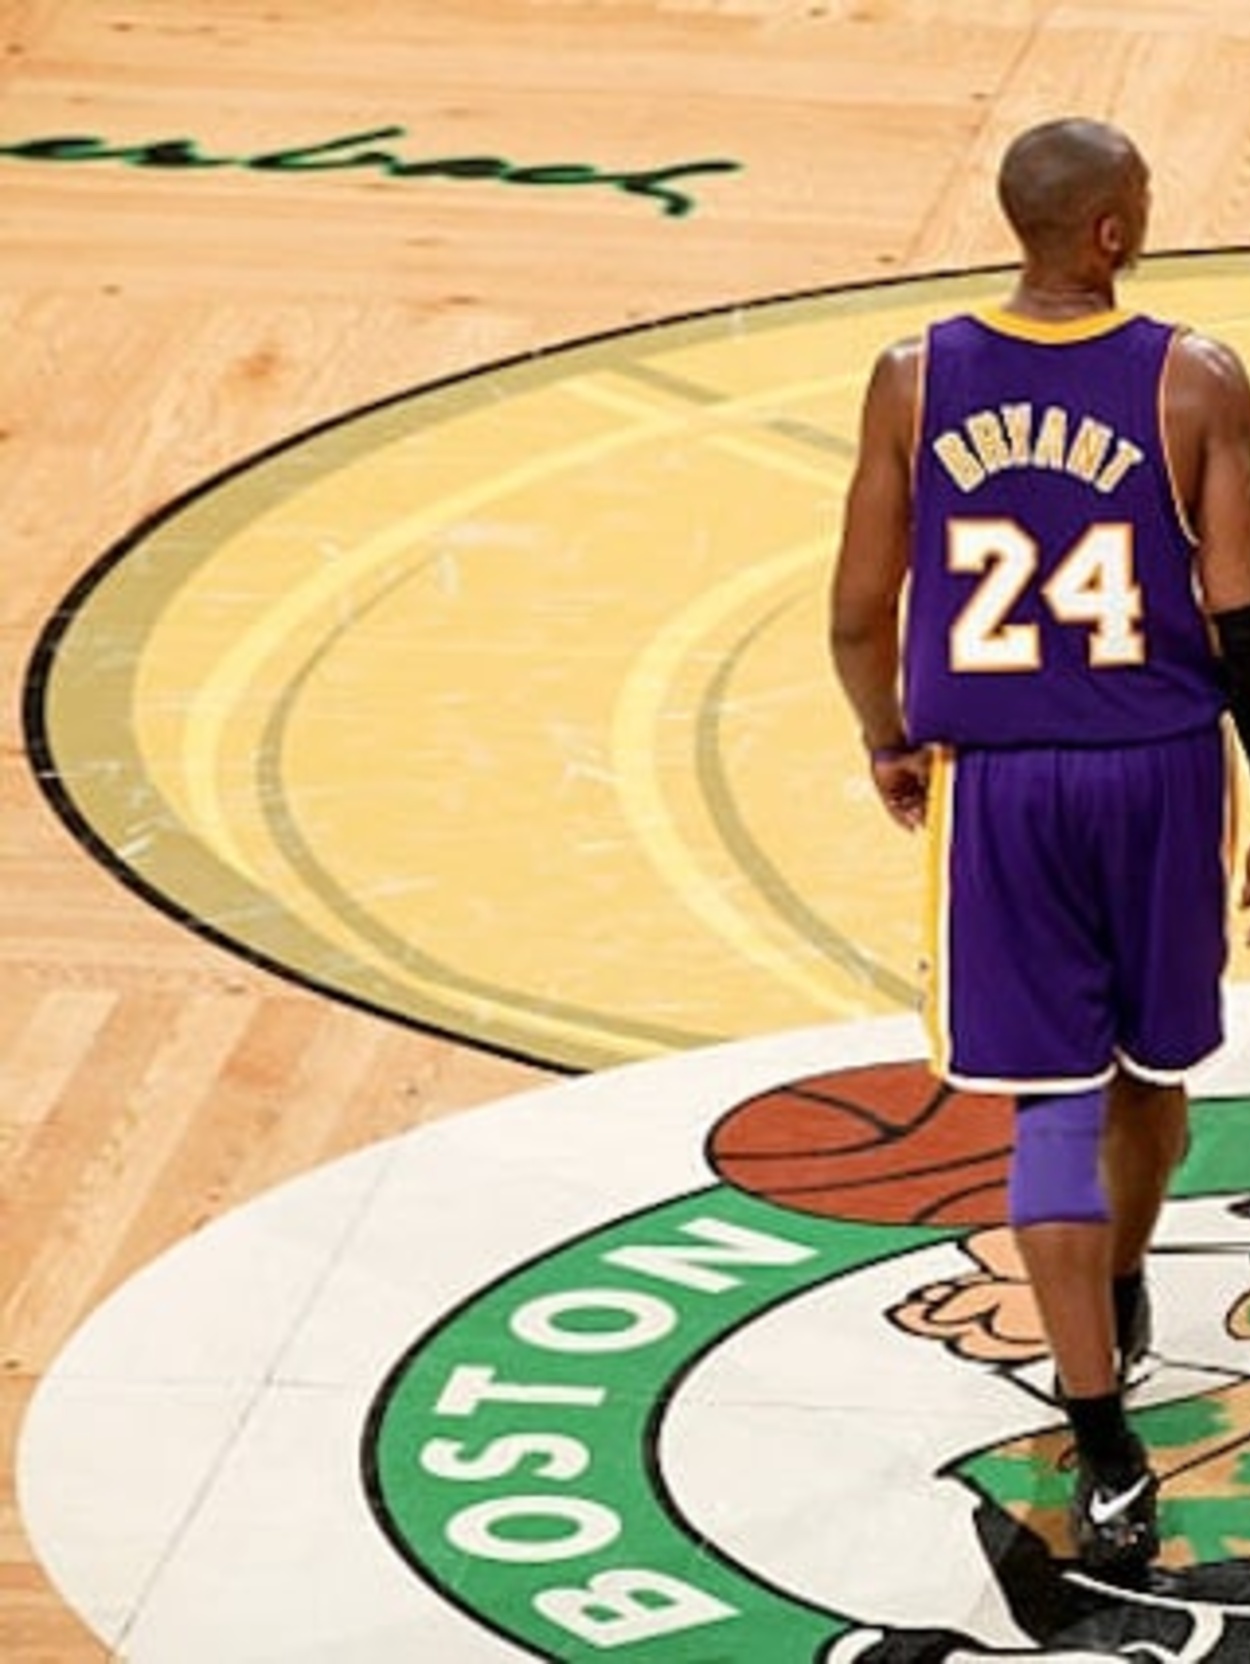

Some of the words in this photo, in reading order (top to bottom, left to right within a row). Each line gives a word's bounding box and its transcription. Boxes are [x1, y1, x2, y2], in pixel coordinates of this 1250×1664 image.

[932, 401, 1145, 493] BRYANT
[945, 515, 1147, 674] 24
[419, 1216, 821, 1649] BOSTON
